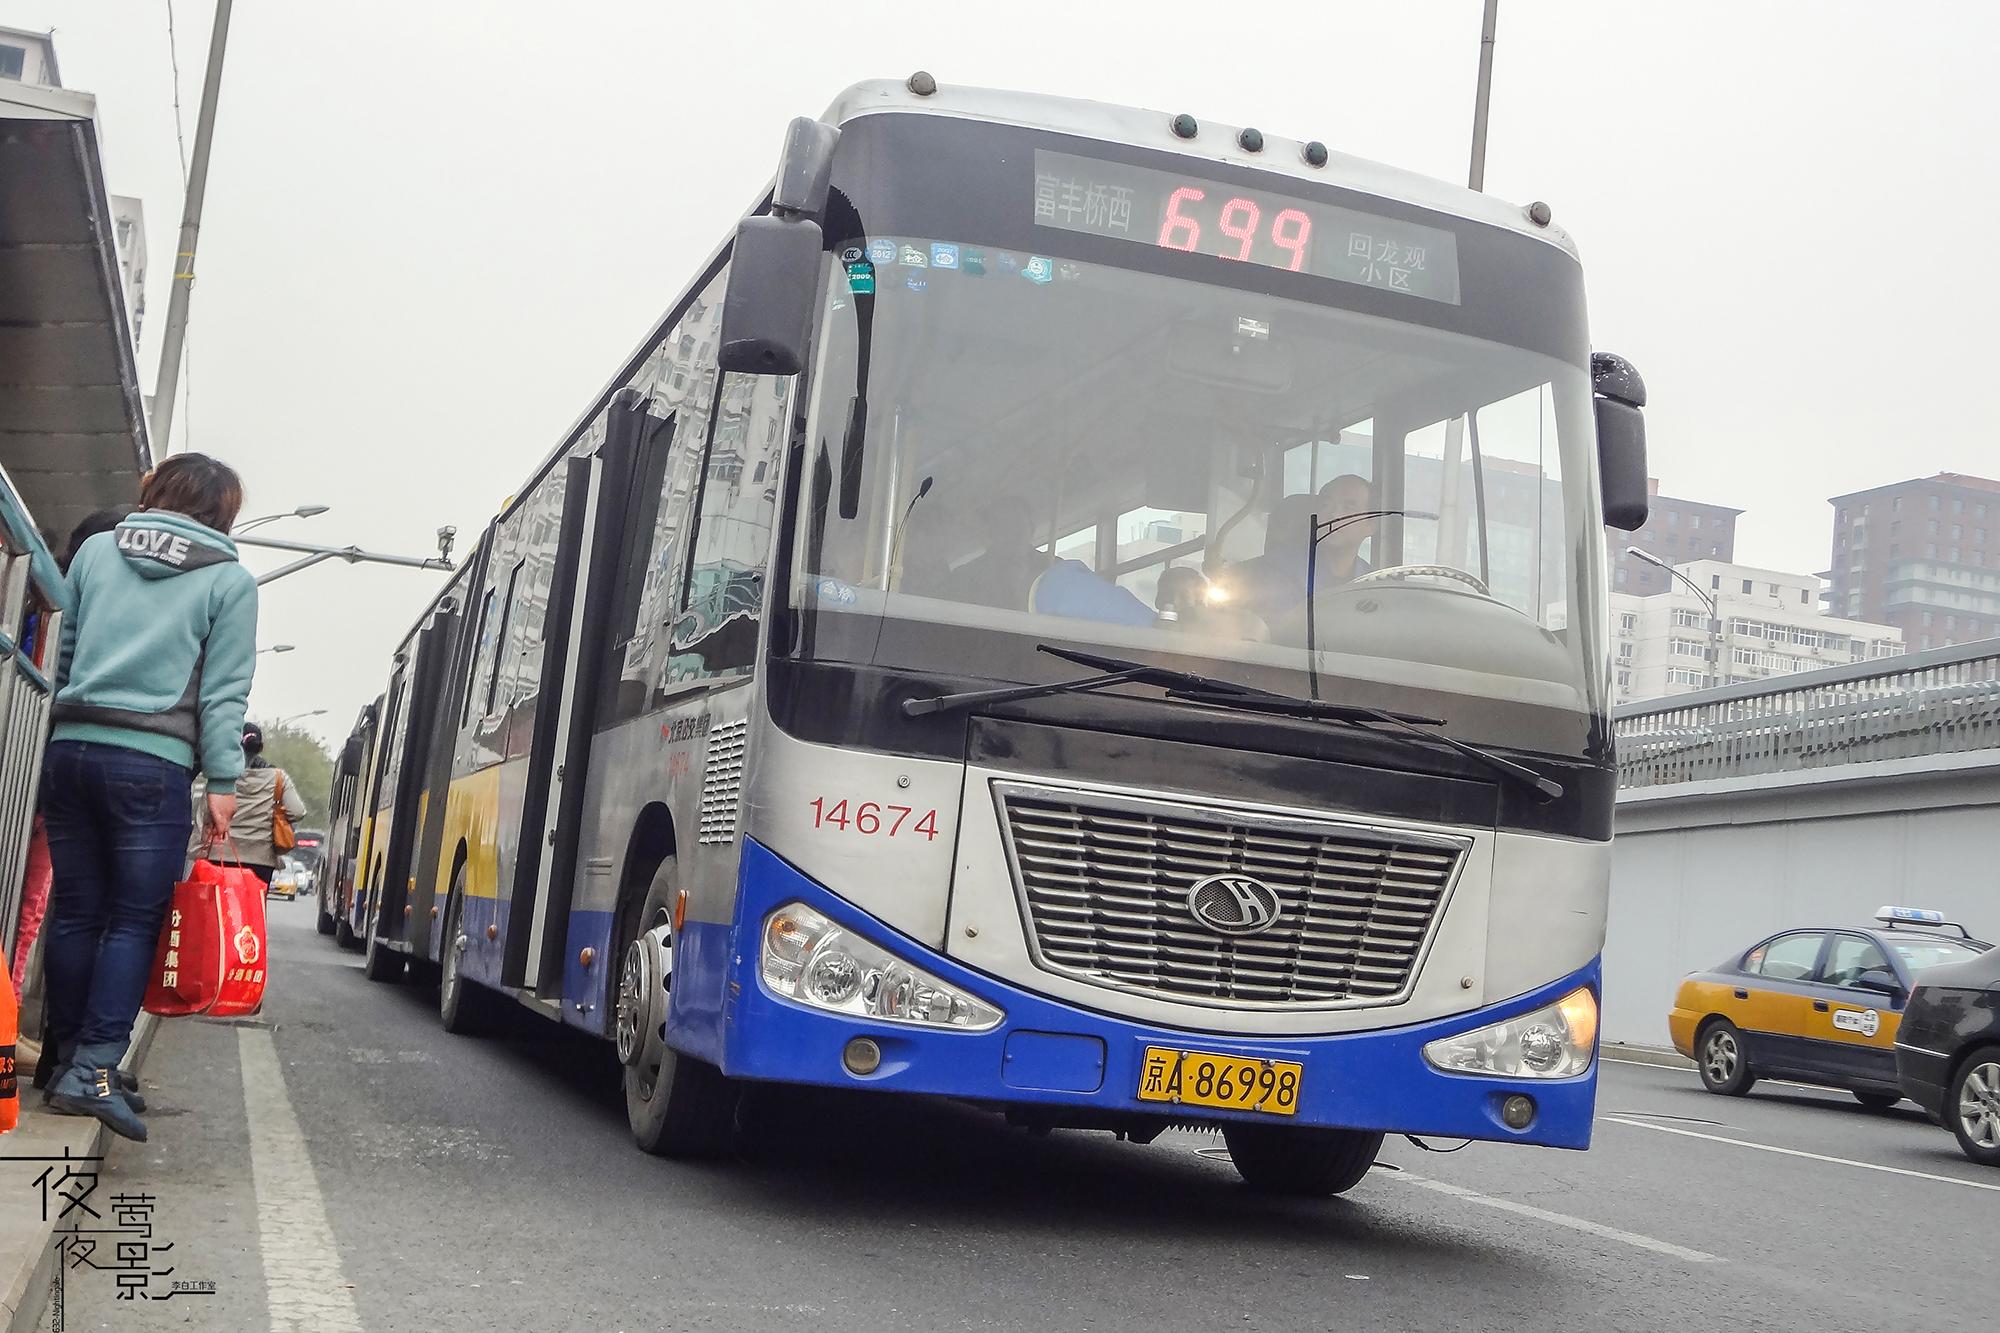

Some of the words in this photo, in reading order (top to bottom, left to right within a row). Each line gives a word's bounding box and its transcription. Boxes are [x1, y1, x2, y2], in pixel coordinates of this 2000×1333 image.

[1036, 173, 1135, 232] 富丰桥西
[1159, 187, 1312, 271] 699
[1347, 232, 1426, 270] 回龙观
[1360, 262, 1411, 291] 小区
[118, 528, 192, 561] LOVE
[810, 797, 939, 842] 14674
